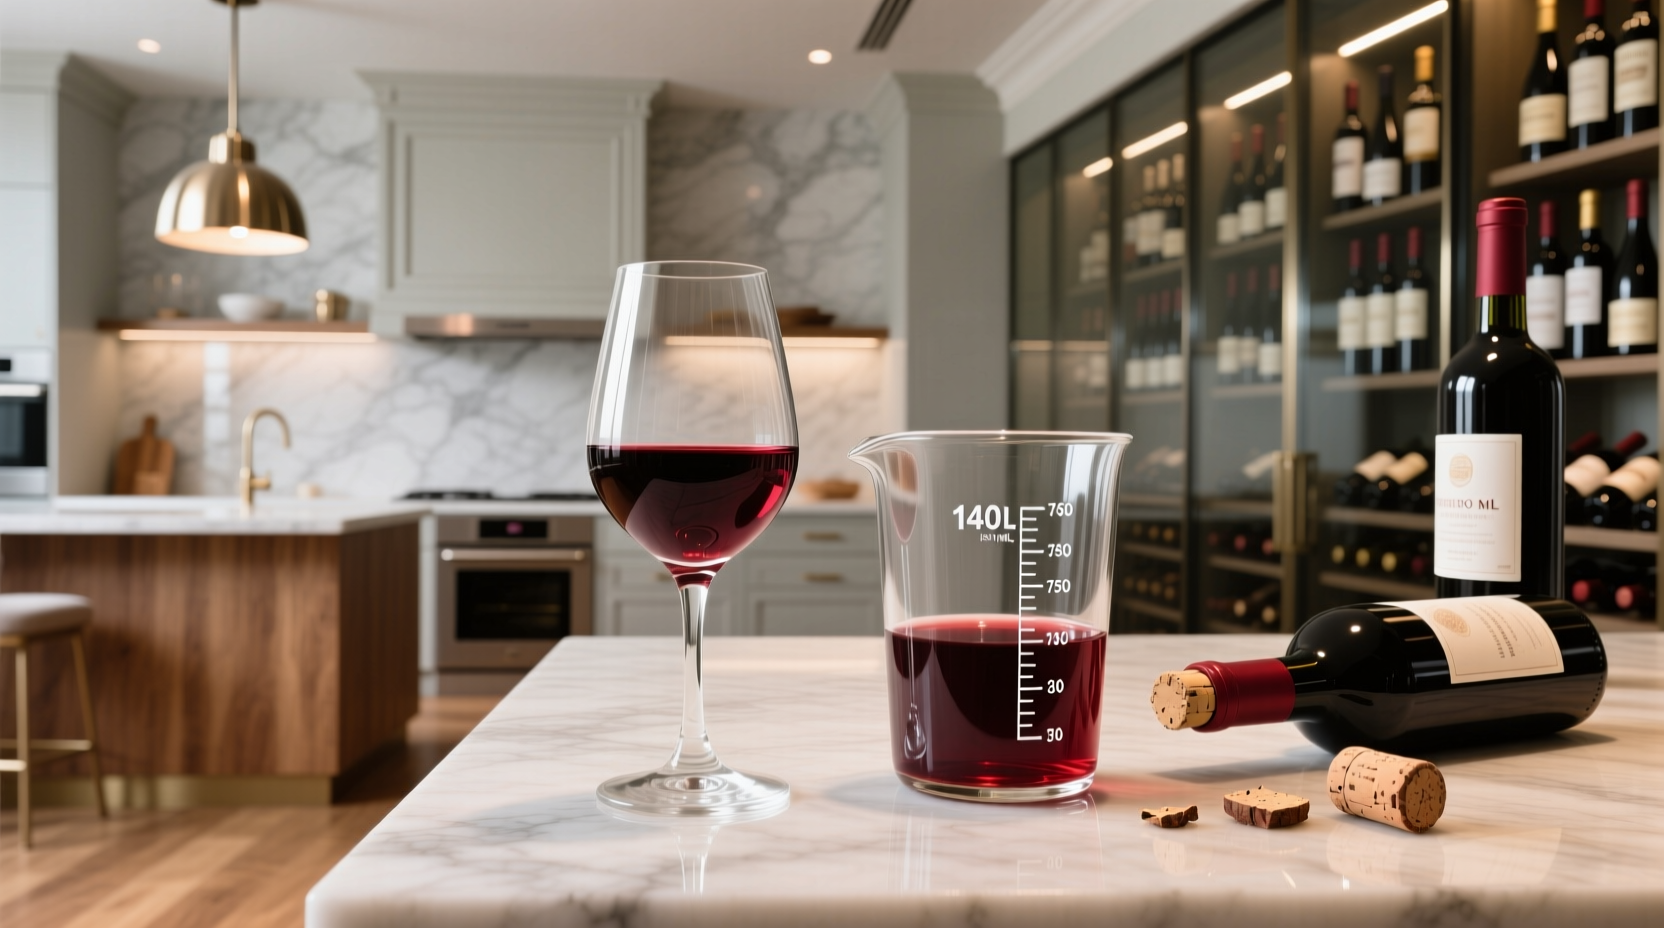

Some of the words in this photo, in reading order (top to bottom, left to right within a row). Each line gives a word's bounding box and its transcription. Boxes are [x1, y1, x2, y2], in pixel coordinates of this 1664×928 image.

[1478, 498, 1500, 510] ML
[953, 504, 1017, 530] 140L
[1046, 578, 1071, 594] 750
